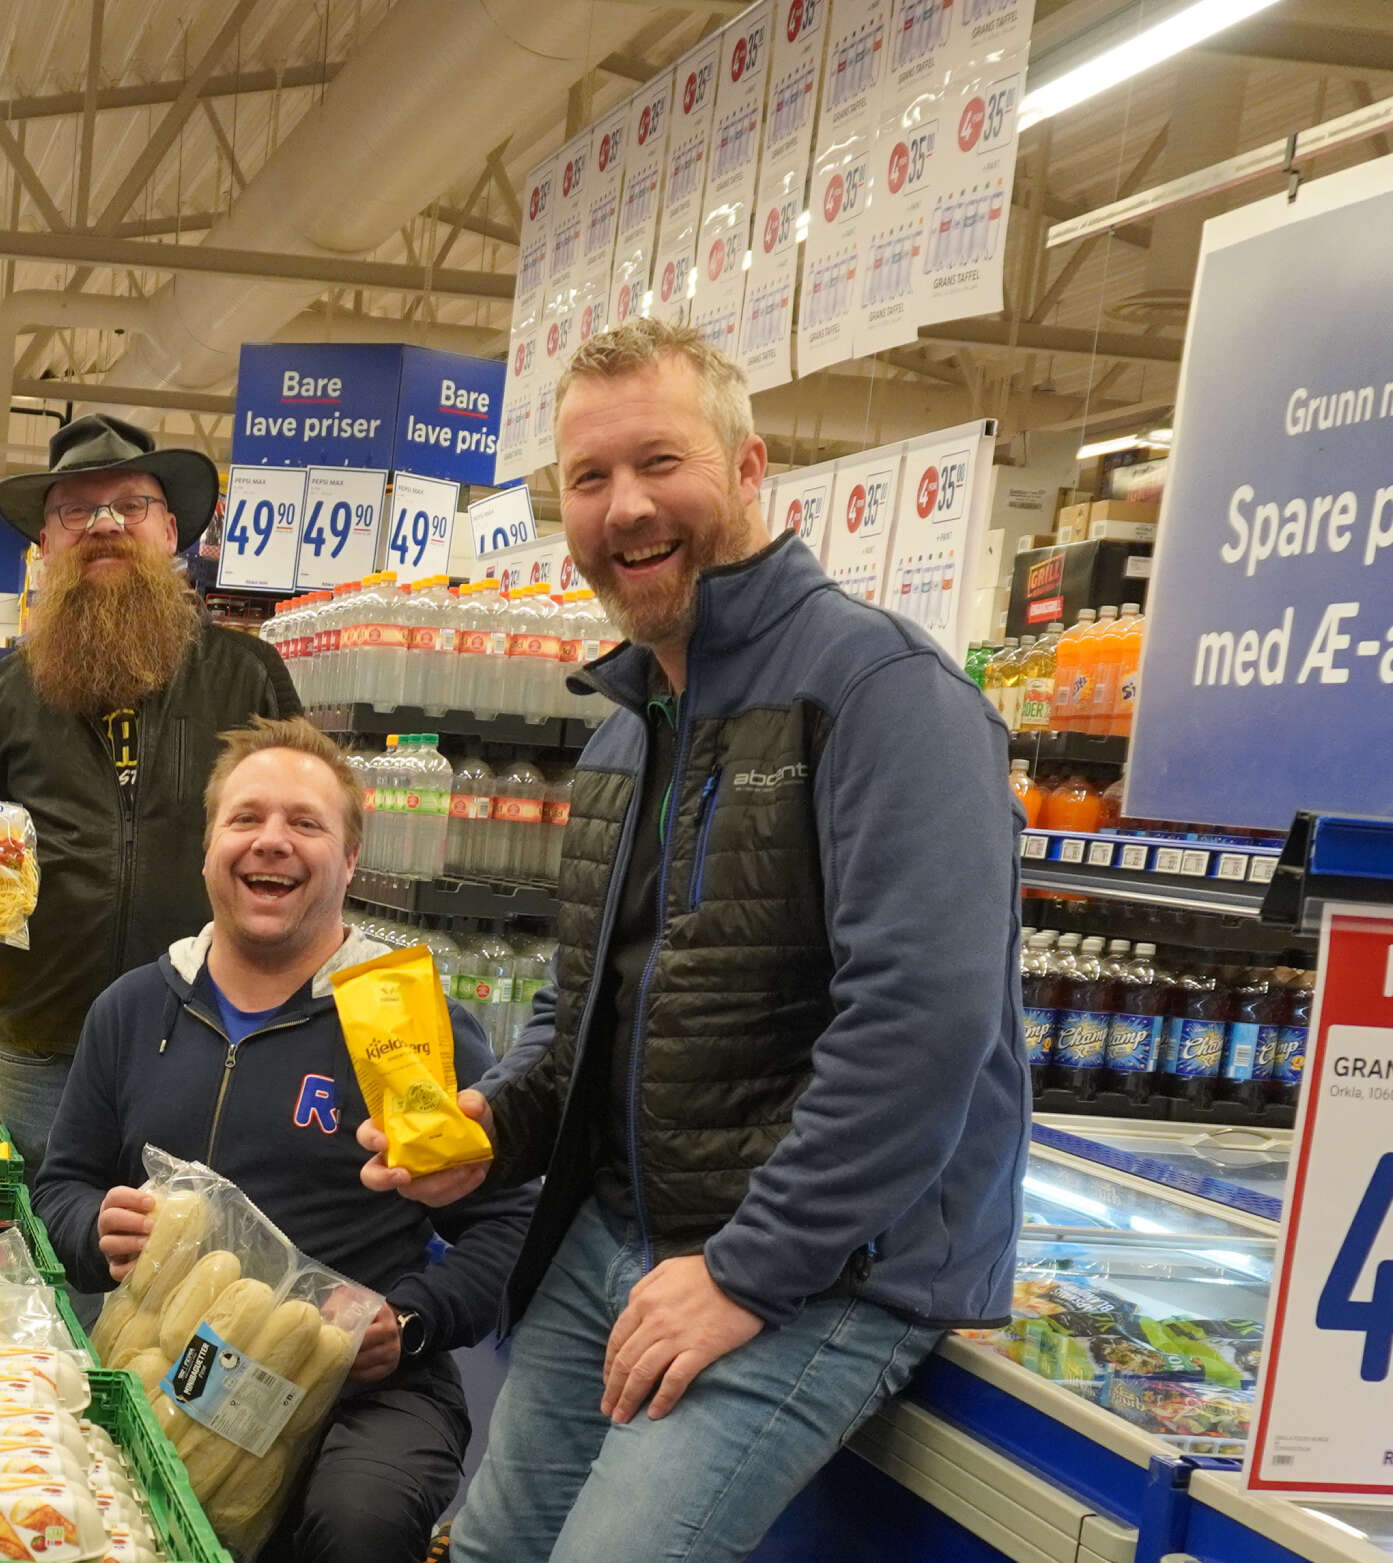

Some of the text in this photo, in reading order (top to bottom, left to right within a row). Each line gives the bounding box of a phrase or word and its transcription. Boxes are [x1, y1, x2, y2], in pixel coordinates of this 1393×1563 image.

[983, 90, 1006, 141] 35
[908, 136, 927, 184] 35
[842, 170, 858, 213] 35
[934, 276, 956, 289] GRANS
[282, 371, 343, 397] Bare
[440, 379, 490, 413] Bare
[245, 411, 381, 442] lave priser
[408, 415, 452, 447] lave
[1285, 386, 1375, 437] Grunn
[251, 478, 266, 486] MAX
[312, 478, 328, 486] PEPSI
[938, 464, 957, 512] 35
[801, 498, 817, 538] 35
[864, 483, 881, 527] 35
[226, 499, 295, 557] 49 90
[303, 500, 374, 558] 49 90
[391, 508, 447, 567] 49 90
[510, 521, 528, 544] 90
[1221, 483, 1358, 577] Spare
[1193, 606, 1295, 687] med
[293, 1073, 341, 1135] R
[1330, 1084, 1363, 1100] Orkla,
